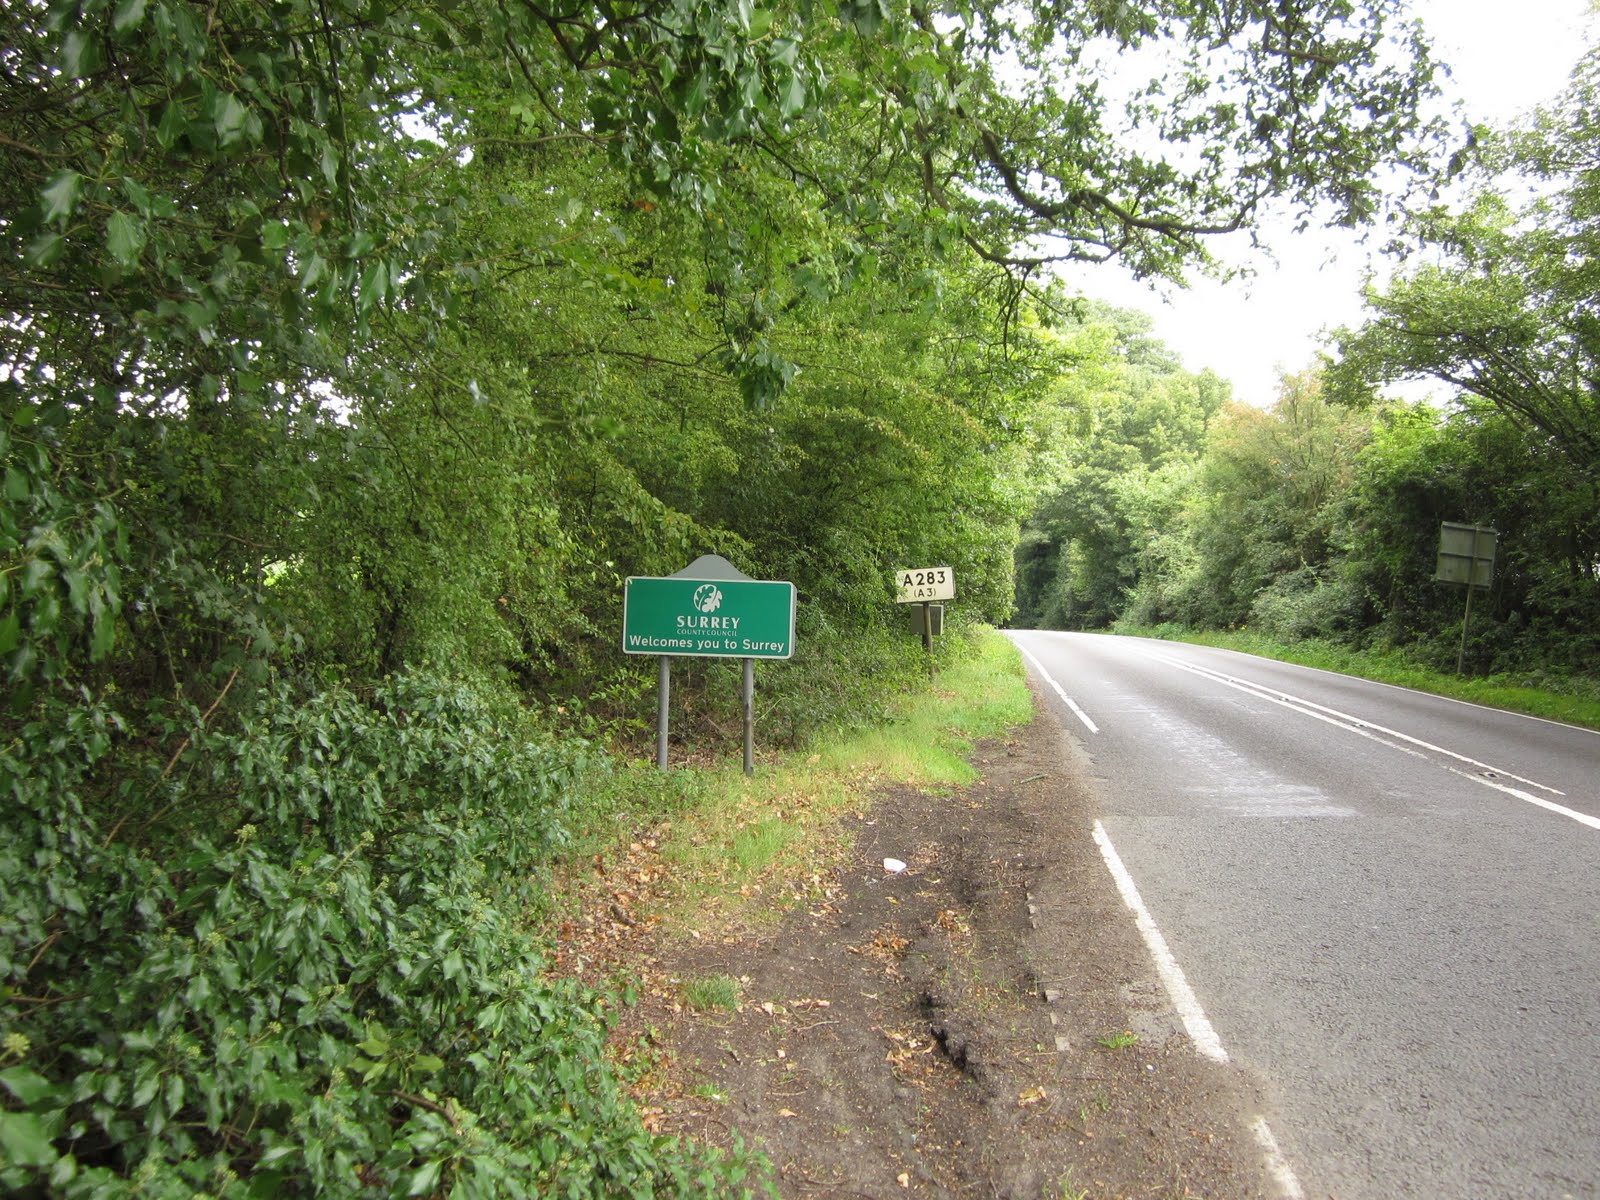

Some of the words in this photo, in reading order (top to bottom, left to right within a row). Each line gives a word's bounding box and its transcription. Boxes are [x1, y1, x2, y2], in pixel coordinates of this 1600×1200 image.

[903, 571, 945, 586] A283
[914, 588, 936, 598] (A3)
[677, 615, 740, 629] SURREY
[629, 635, 693, 648] Welcomes
[697, 640, 719, 650] you
[725, 640, 737, 650] to
[742, 640, 784, 653] Surrey
